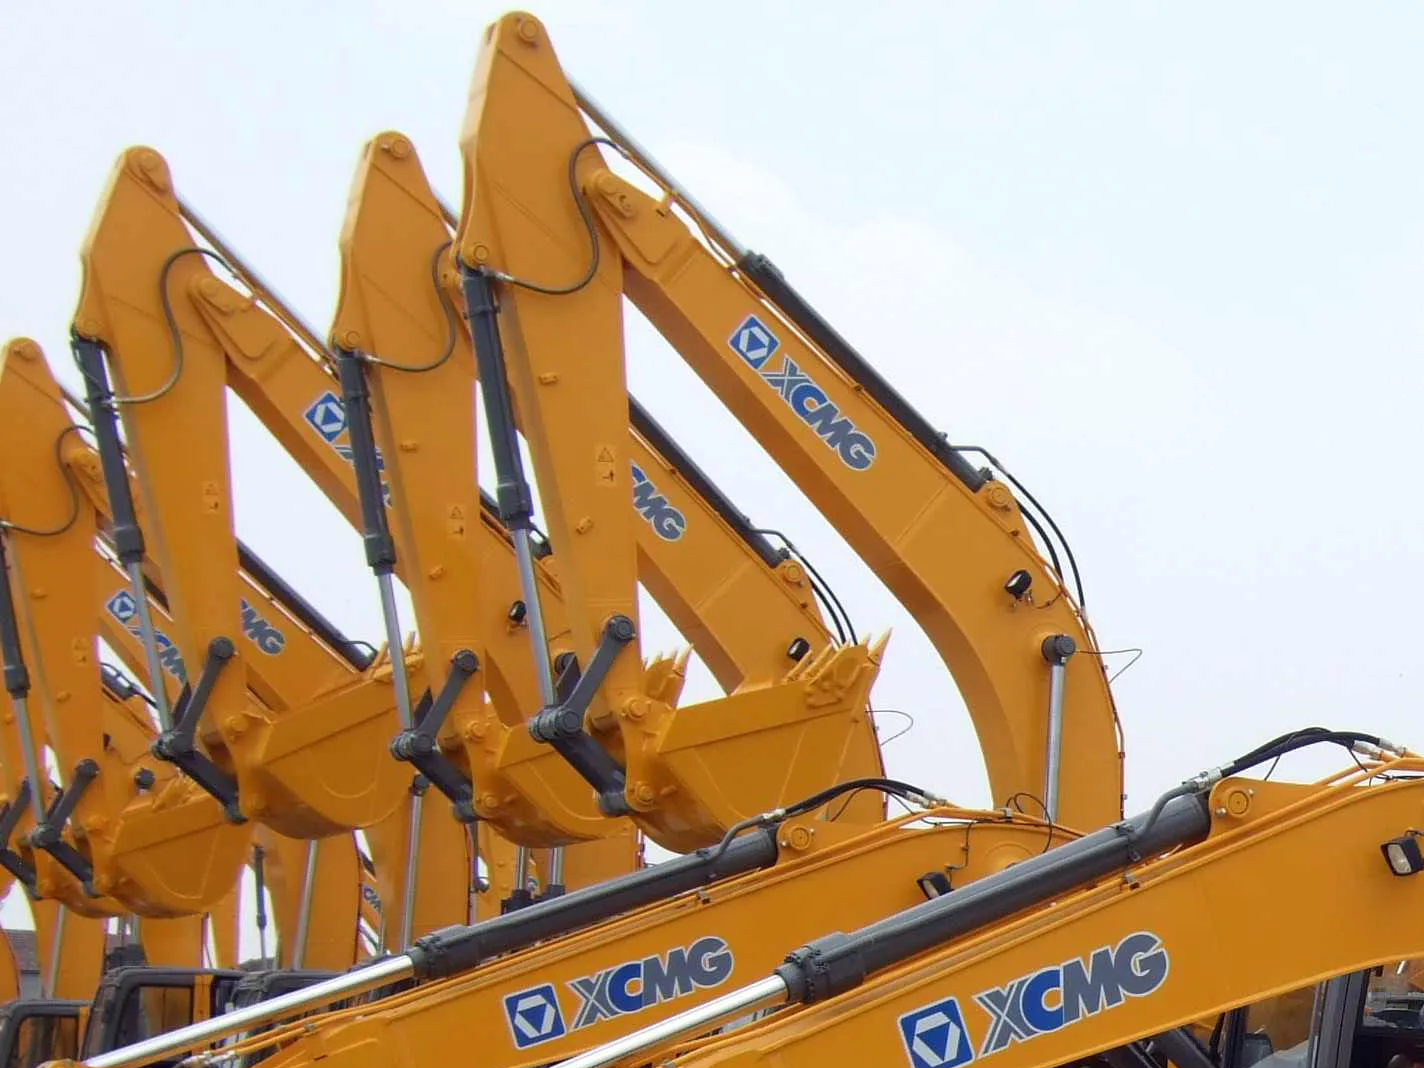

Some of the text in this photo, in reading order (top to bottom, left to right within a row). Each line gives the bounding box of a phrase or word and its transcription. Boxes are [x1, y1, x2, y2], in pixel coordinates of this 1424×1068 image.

[759, 353, 876, 471] XCMG
[630, 459, 686, 542] MG
[565, 936, 734, 1033] XCMG
[972, 931, 1170, 1059] XCMG
